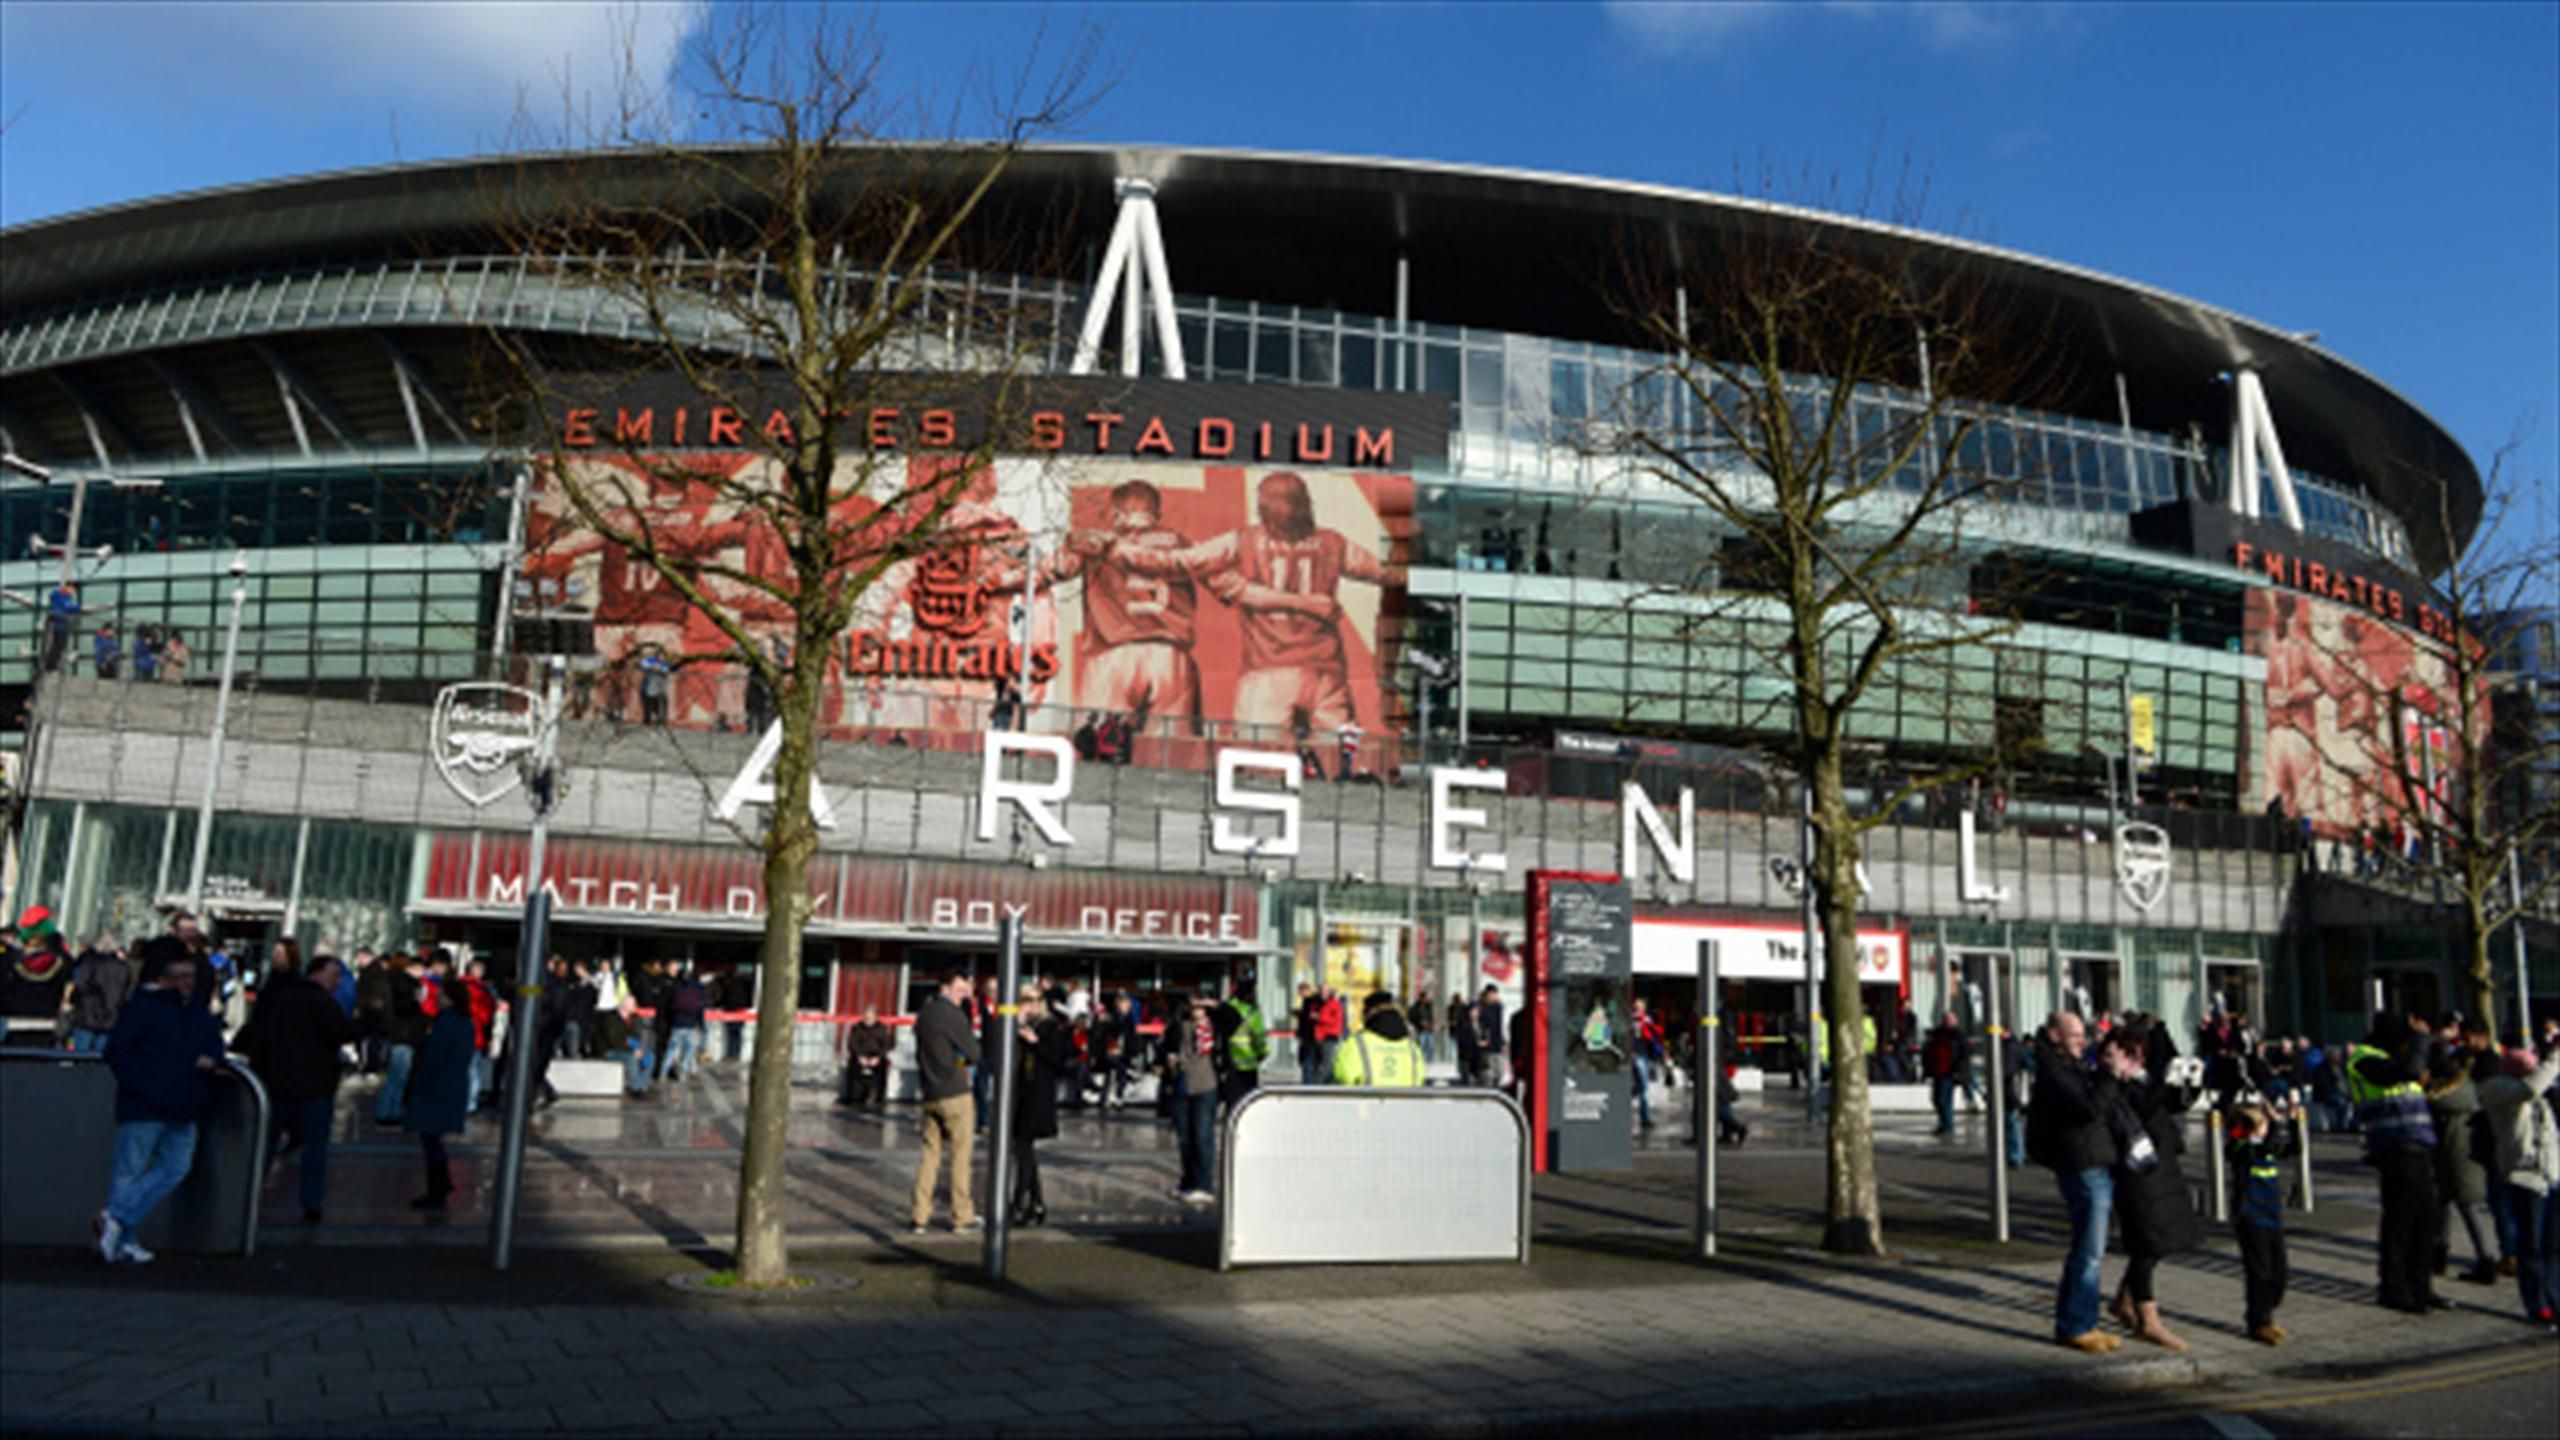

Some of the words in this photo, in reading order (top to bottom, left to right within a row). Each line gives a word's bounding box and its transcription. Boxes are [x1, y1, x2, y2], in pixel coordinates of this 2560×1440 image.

[564, 407, 956, 446] EMIRAES
[1031, 411, 1394, 464] STADIUM
[2236, 541, 2403, 620] EMIRATES
[710, 713, 2010, 900] ARSENL
[489, 874, 681, 913] MATCH
[1079, 905, 1243, 942] OFFICE
[1767, 939, 1798, 960] The
